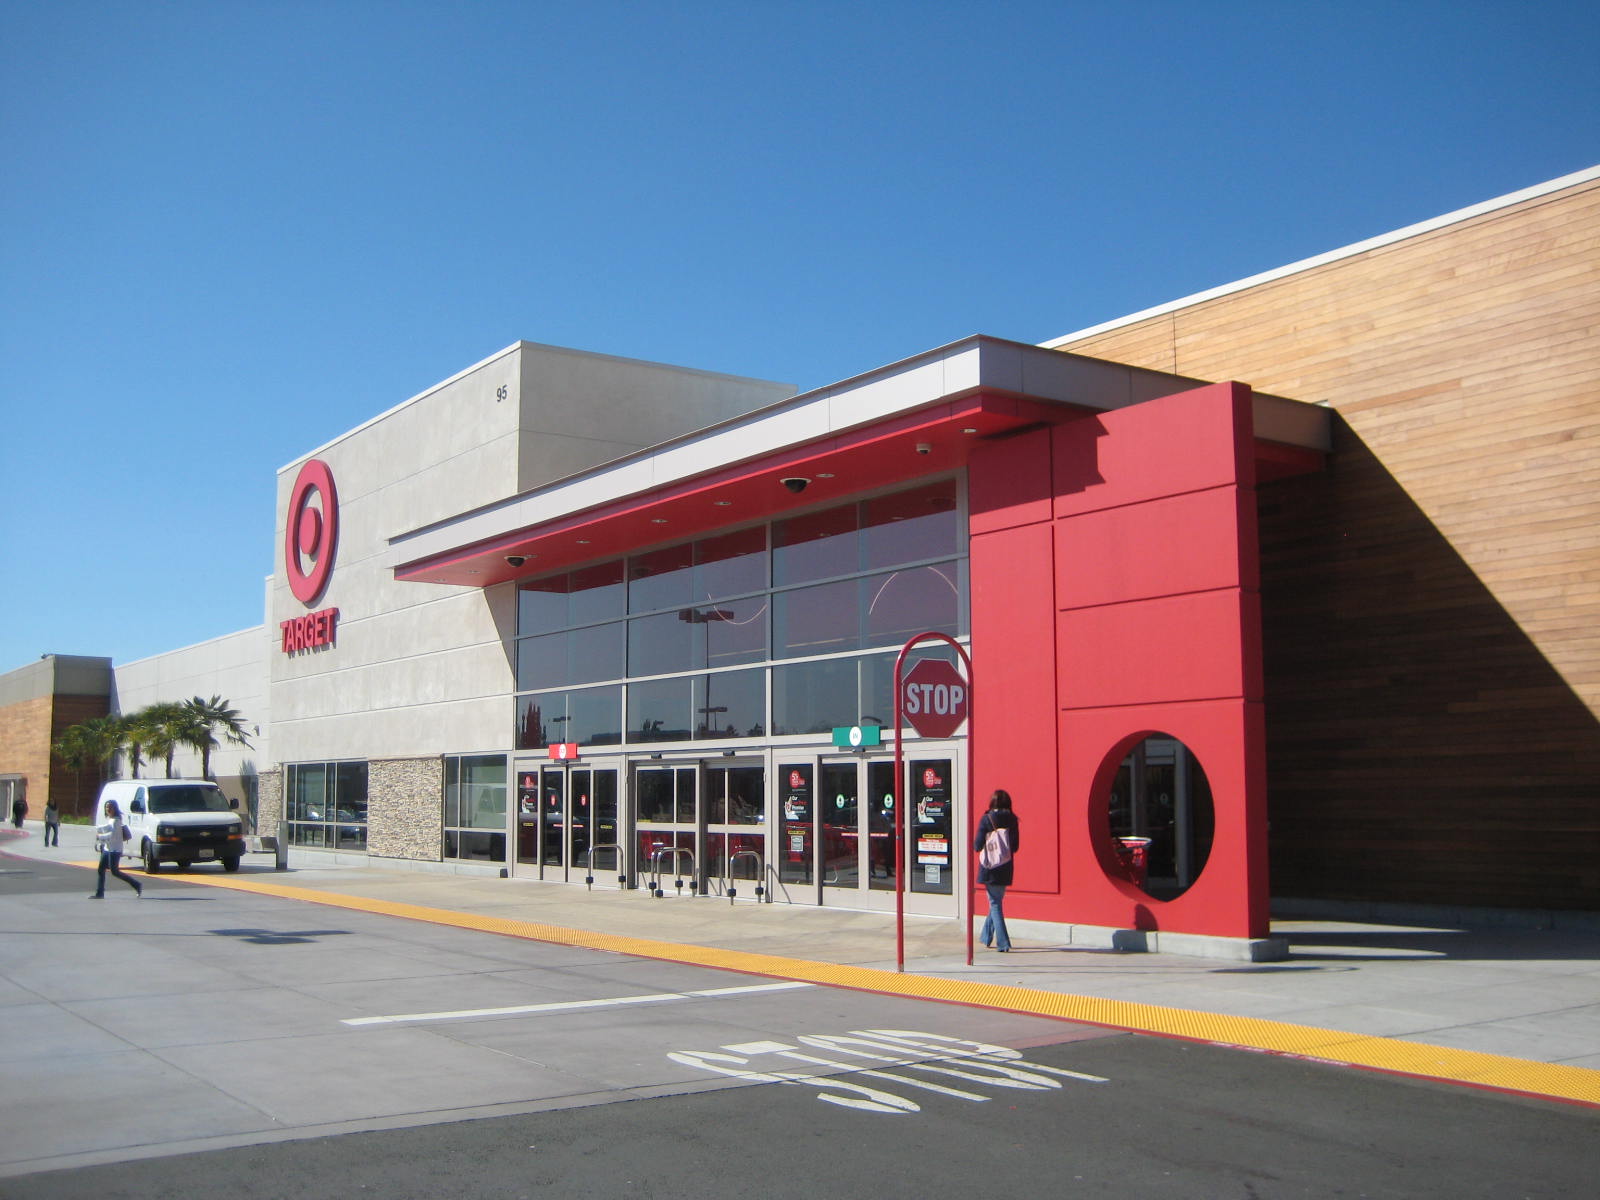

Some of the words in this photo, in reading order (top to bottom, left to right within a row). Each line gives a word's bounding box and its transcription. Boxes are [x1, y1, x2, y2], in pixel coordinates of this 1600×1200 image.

[496, 384, 508, 402] 95
[280, 607, 337, 653] TARGET
[906, 682, 964, 715] STOP
[666, 1029, 1110, 1113] STOP
